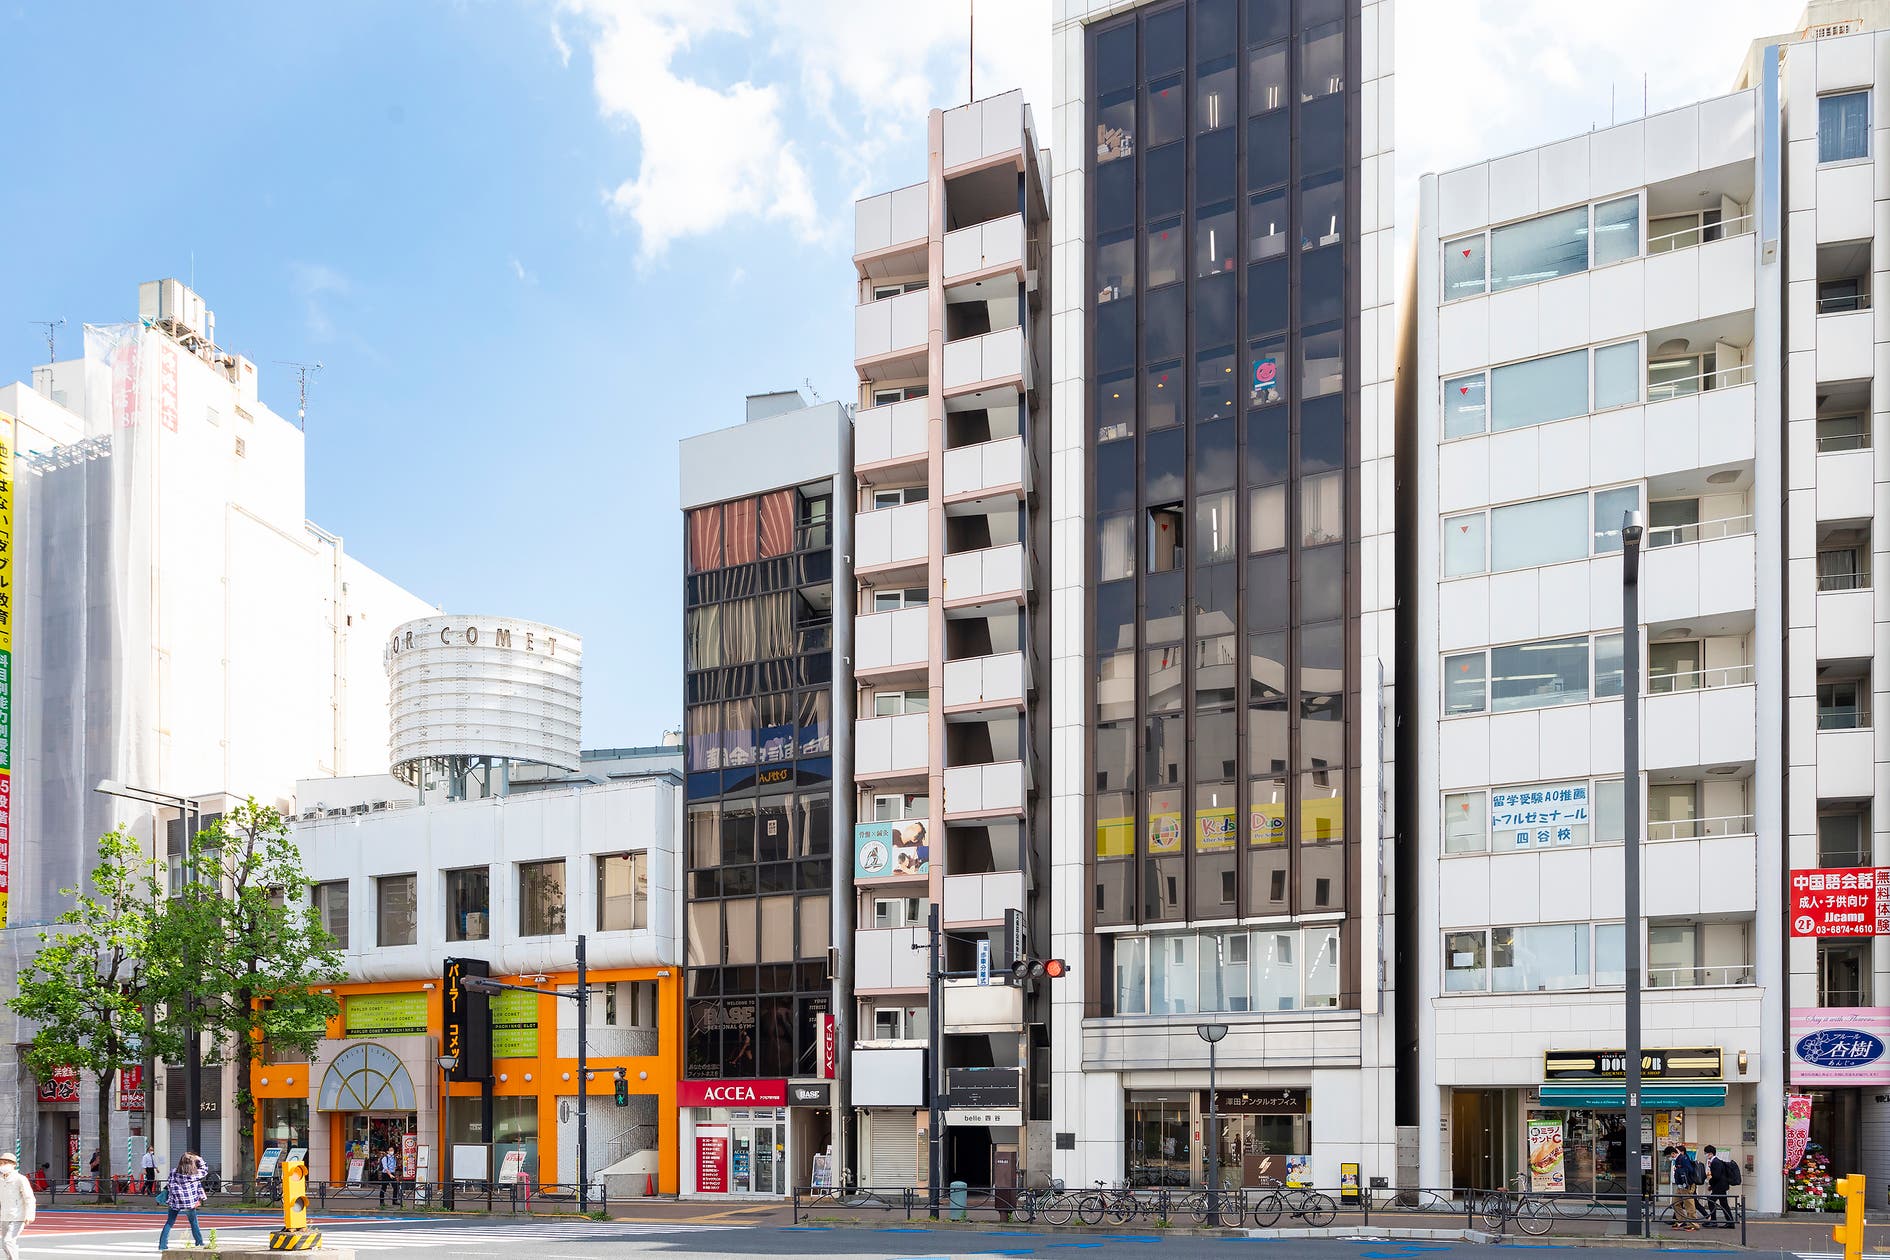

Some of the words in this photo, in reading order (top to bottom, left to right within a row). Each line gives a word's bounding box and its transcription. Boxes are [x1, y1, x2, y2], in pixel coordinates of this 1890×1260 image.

[441, 626, 557, 656] COMET
[1493, 787, 1586, 808] 留学受験AO推薦
[1201, 816, 1236, 837] Kids
[1251, 812, 1284, 831] Duo
[1492, 808, 1588, 826] トフルゼミナール
[1516, 828, 1571, 844] 四谷校
[1793, 873, 1874, 891] 中国語会話
[1799, 894, 1869, 909] 成人・子供向け
[1798, 919, 1812, 930] 2F
[1816, 925, 1873, 934] 03-6874-4610
[448, 963, 460, 1013] パーラー
[704, 1006, 755, 1025] BASE
[1830, 1040, 1873, 1058] 杏樹
[704, 1086, 756, 1100] ACCEA
[1540, 1126, 1560, 1135] ミラノ
